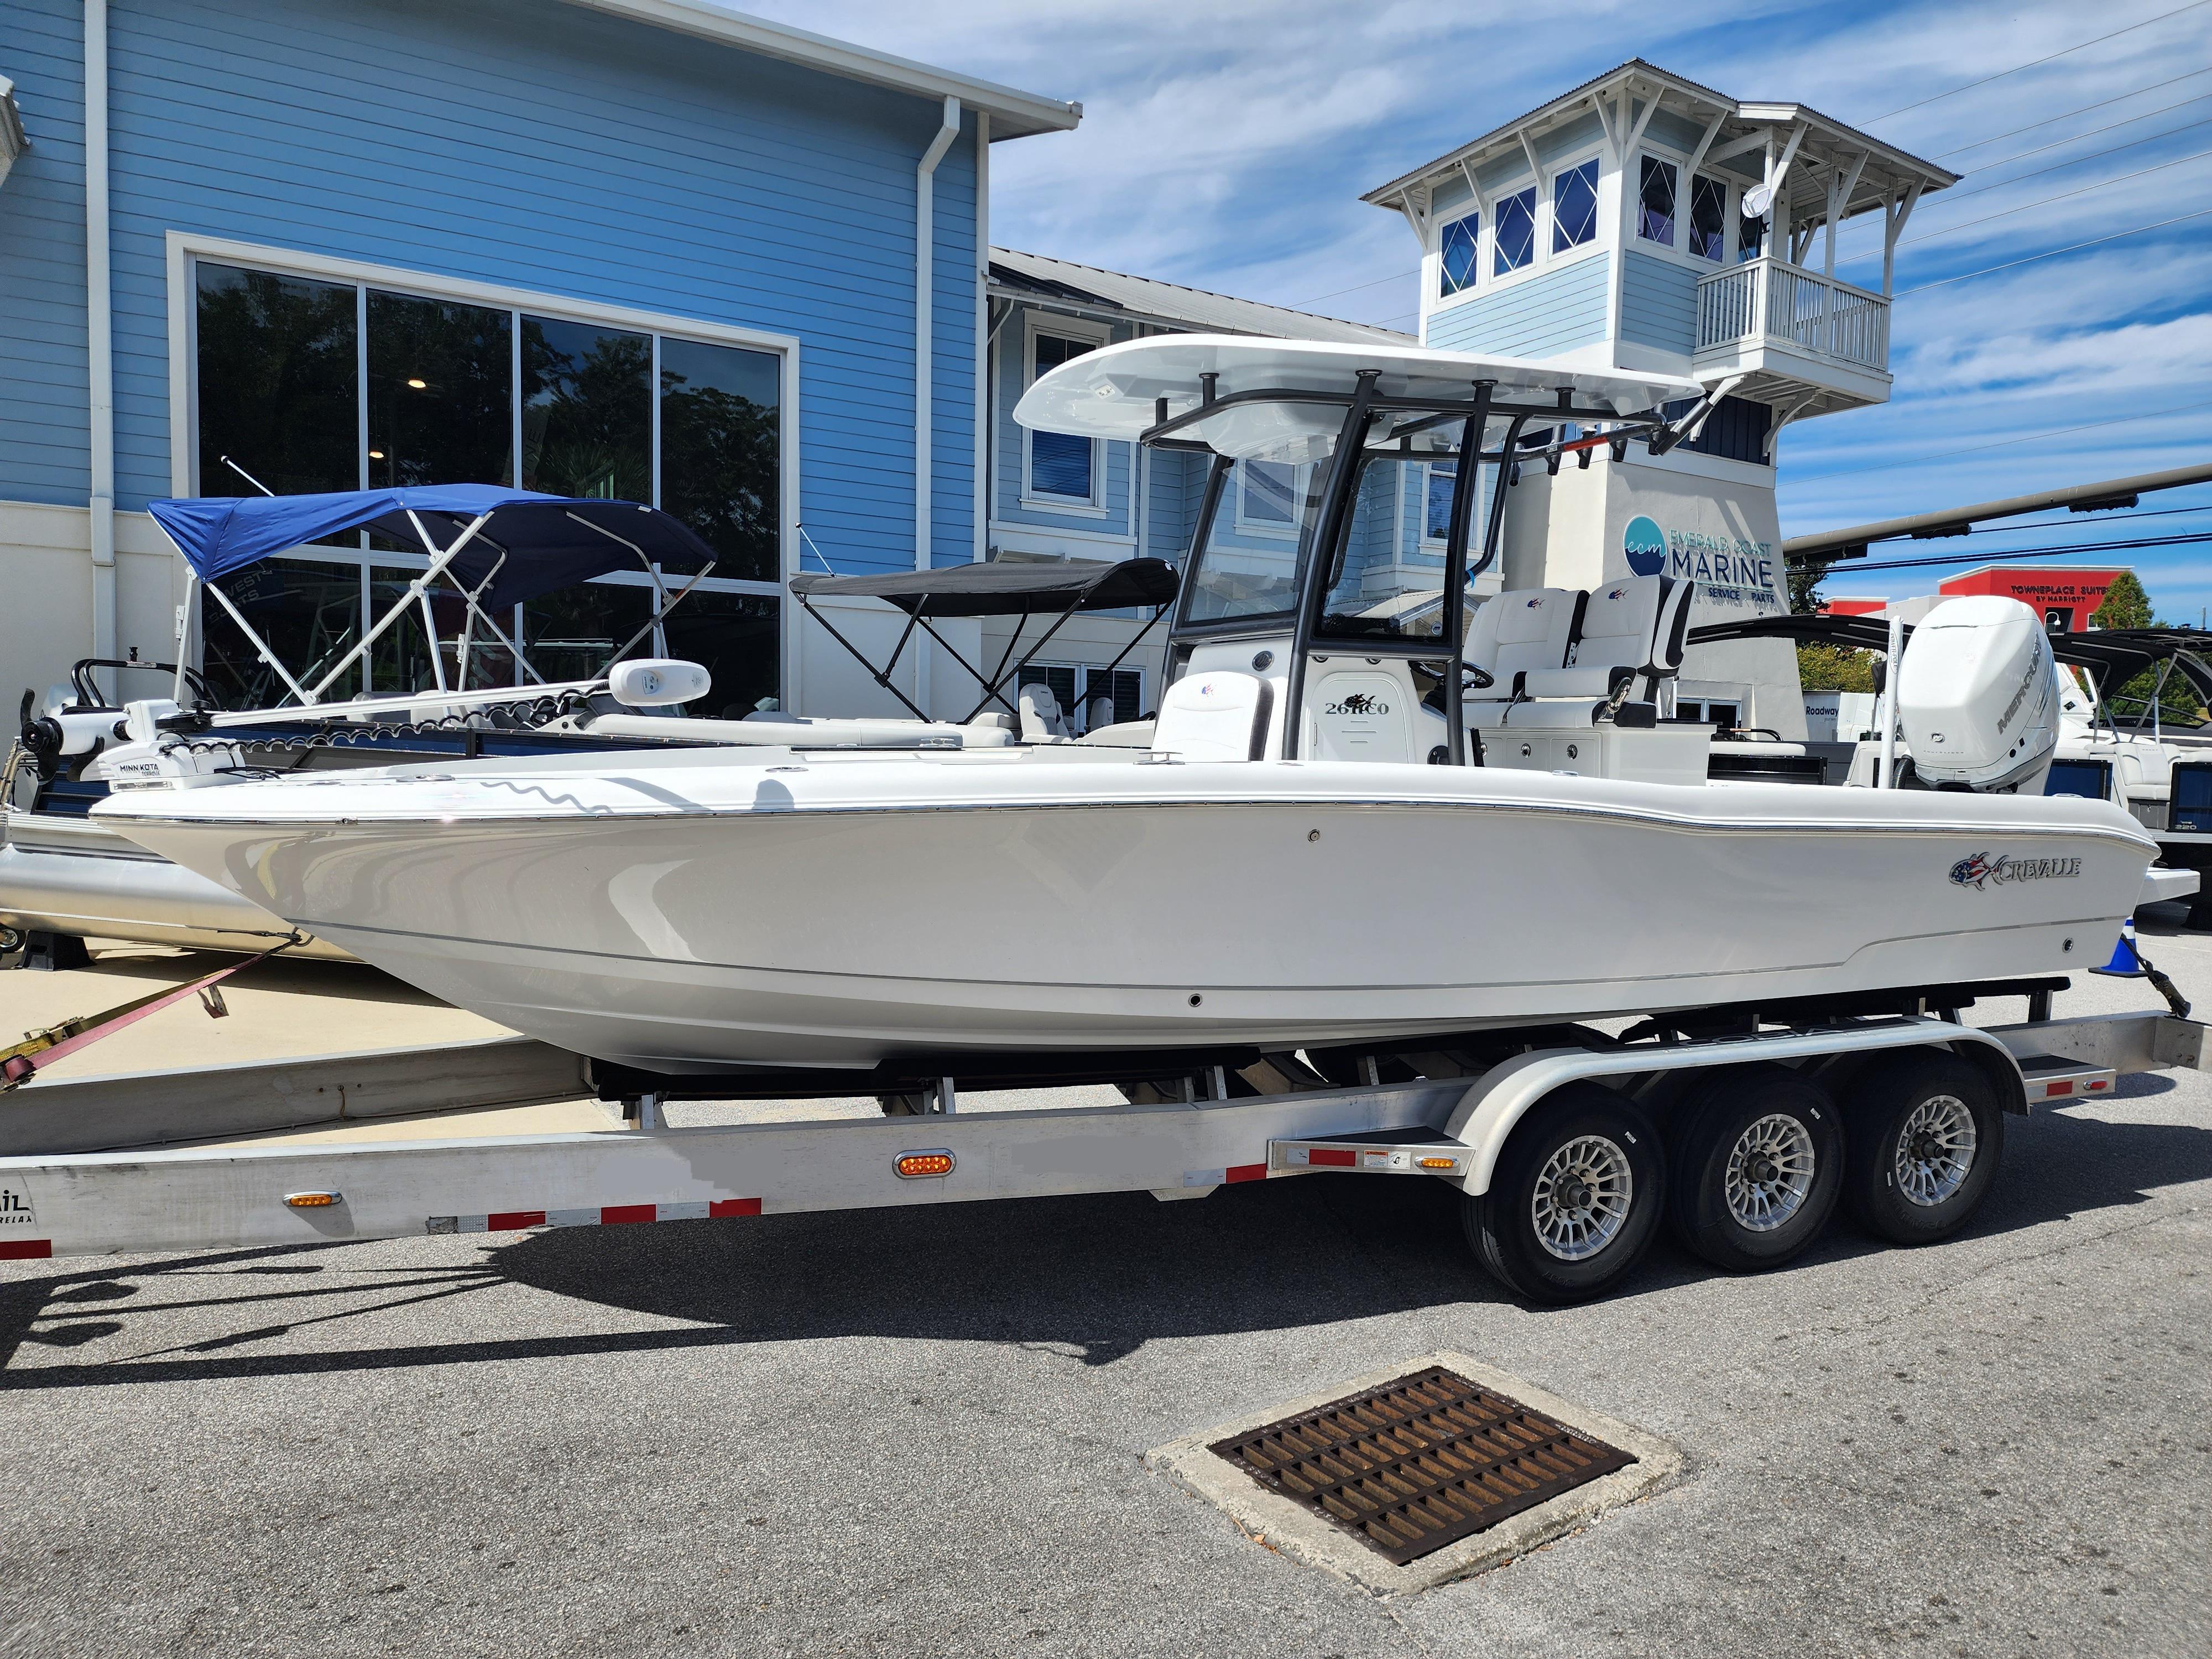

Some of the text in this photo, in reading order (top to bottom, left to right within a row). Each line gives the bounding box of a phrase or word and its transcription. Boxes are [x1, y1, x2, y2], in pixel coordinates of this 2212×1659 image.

[1625, 539, 1667, 557] ecm
[1670, 529, 1772, 557] EMERALD COAST
[1673, 549, 1773, 588] MARINE
[1709, 587, 1775, 604] SERVICE PARTS
[2011, 585, 2075, 595] TOWNEPLACE
[1806, 706, 1839, 717] Roadway
[2000, 858, 2081, 882] CREVALLE
